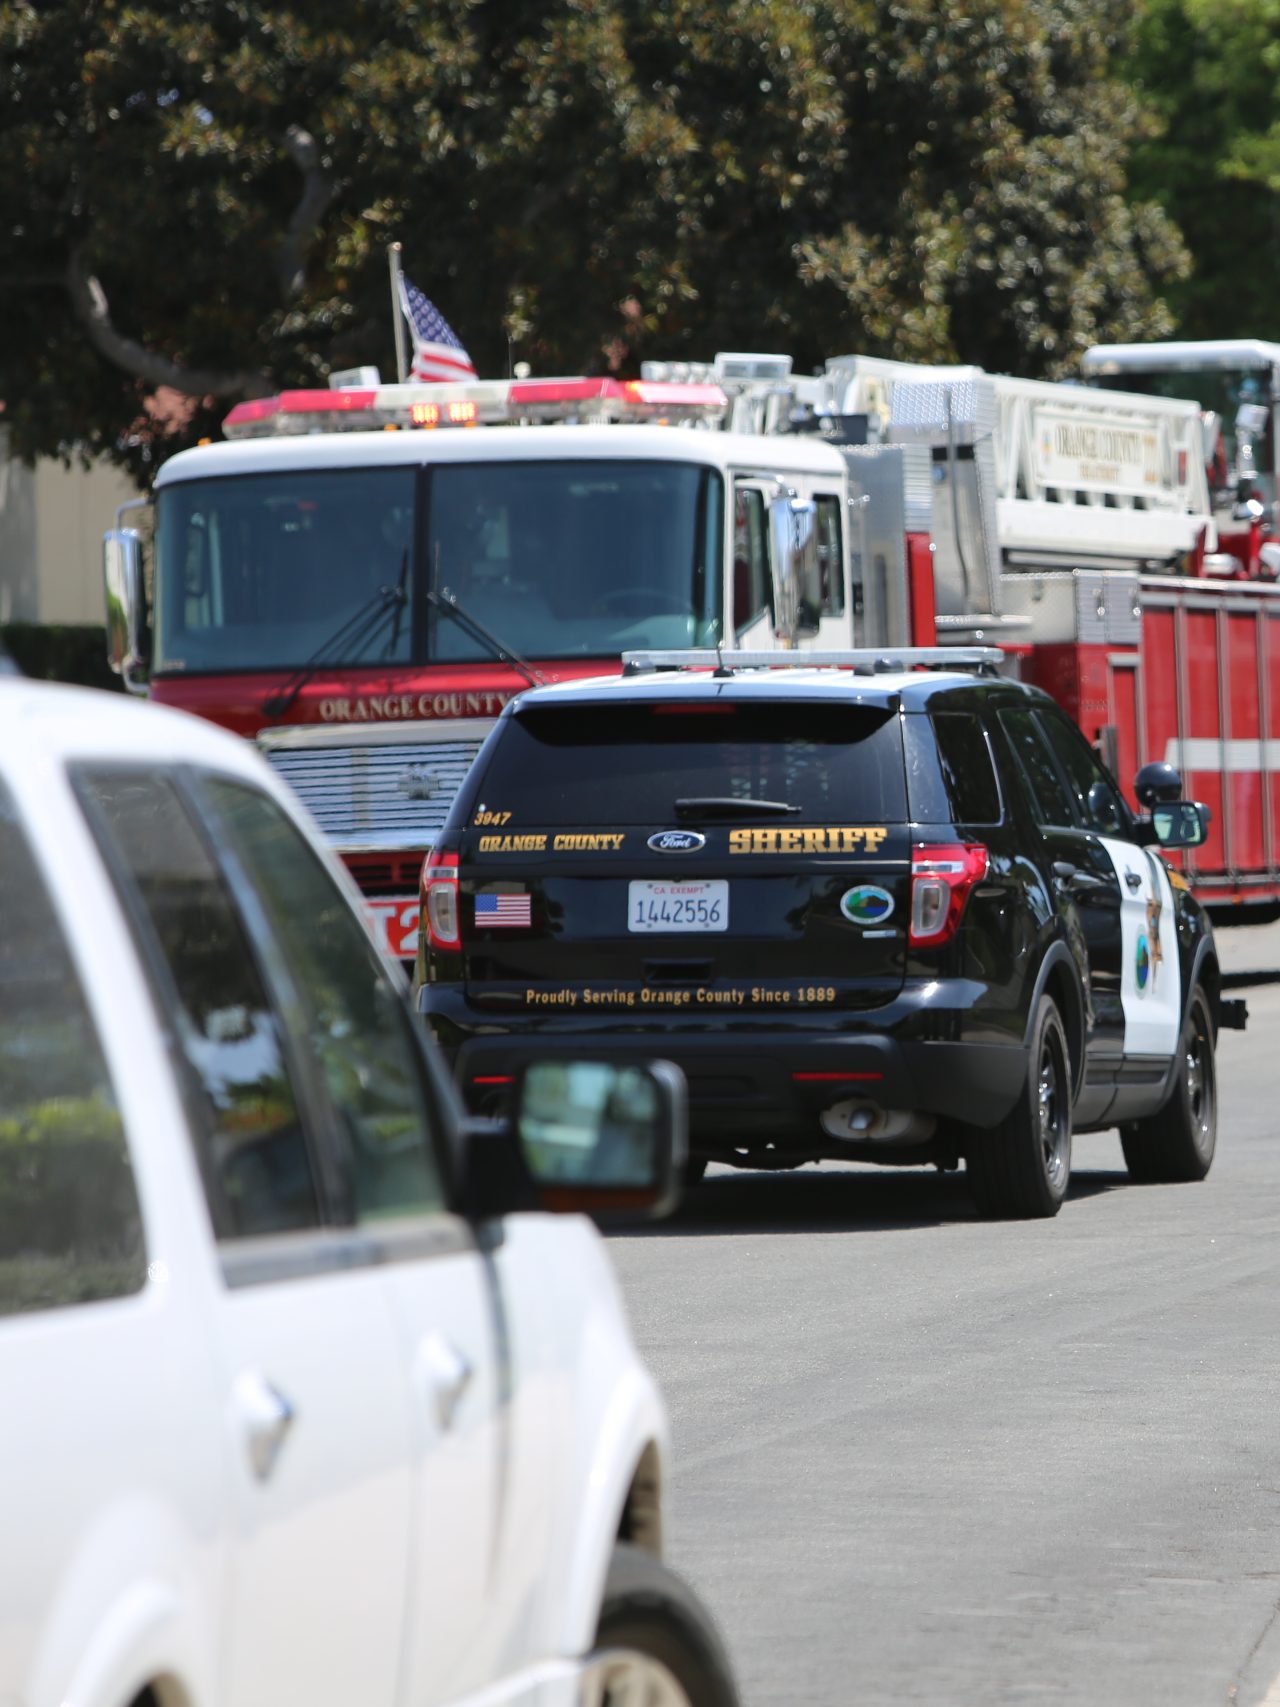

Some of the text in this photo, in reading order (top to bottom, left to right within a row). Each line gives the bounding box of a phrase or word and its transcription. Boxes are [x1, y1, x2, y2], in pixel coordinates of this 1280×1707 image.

[319, 691, 512, 720] ORANGE COUNTY
[474, 812, 512, 826] 3947
[479, 833, 625, 852] ORANGE COUNTY
[659, 833, 692, 849] Ford
[729, 827, 888, 854] SHERIFF
[635, 900, 720, 924] 1442556
[526, 987, 836, 1006] Proudly Serving Orange County Since 1889
